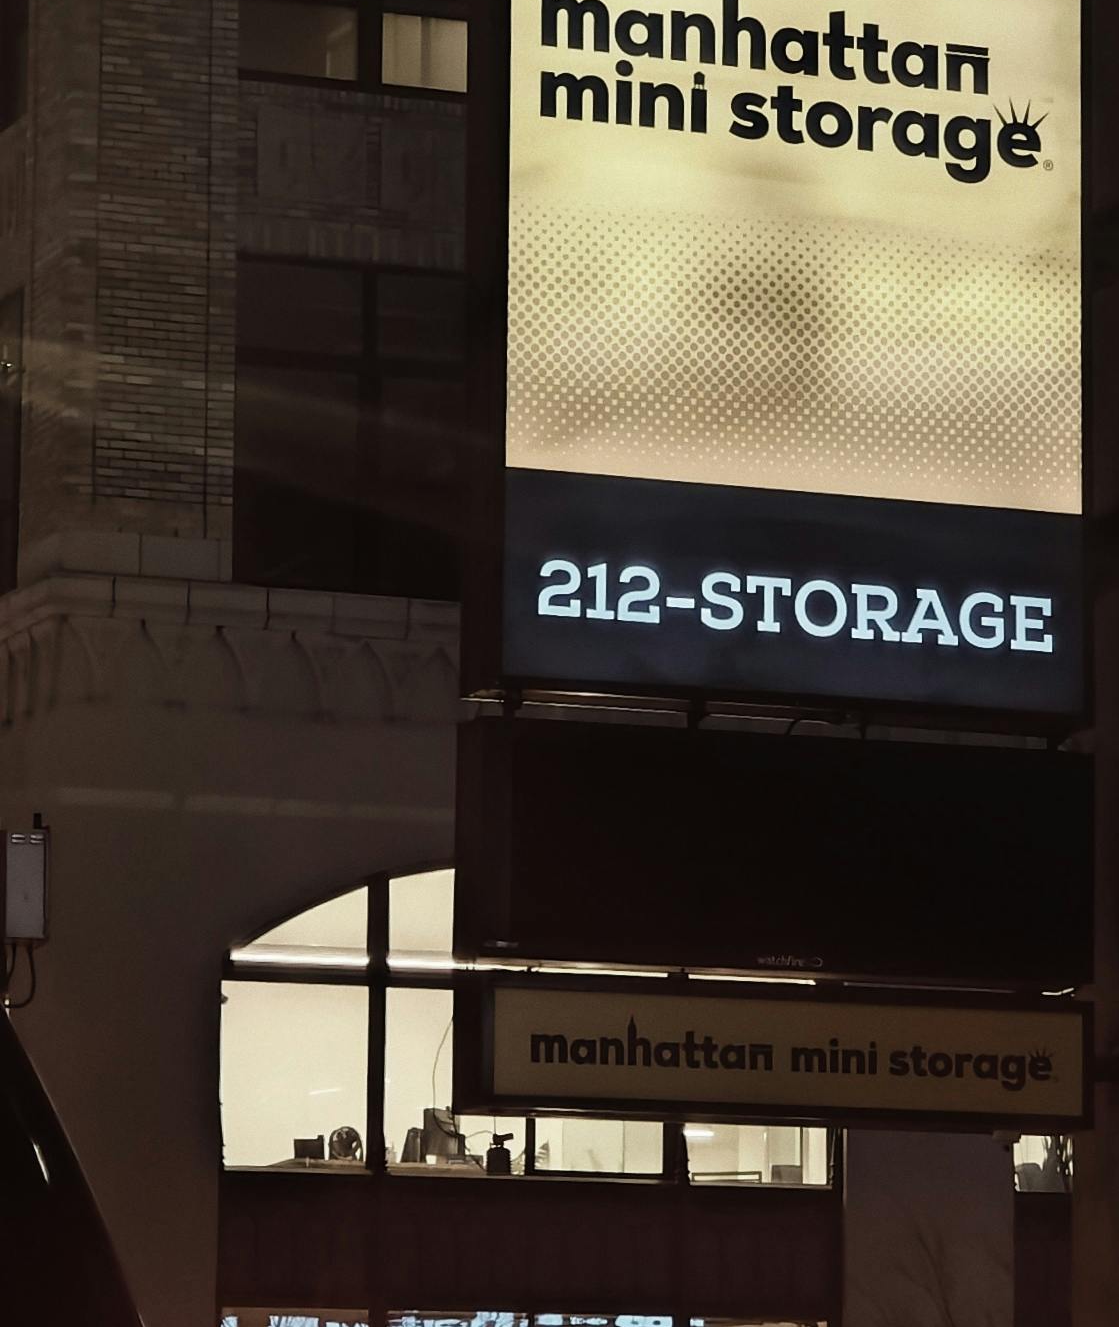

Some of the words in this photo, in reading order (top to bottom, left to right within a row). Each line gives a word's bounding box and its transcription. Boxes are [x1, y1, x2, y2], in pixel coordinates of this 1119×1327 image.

[540, 60, 708, 134] mini
[730, 86, 1048, 184] storage
[537, 559, 1053, 653] 212-STORAGE
[530, 1016, 773, 1071] manhattan
[791, 1038, 877, 1074] mini
[889, 1045, 1053, 1091] storage
